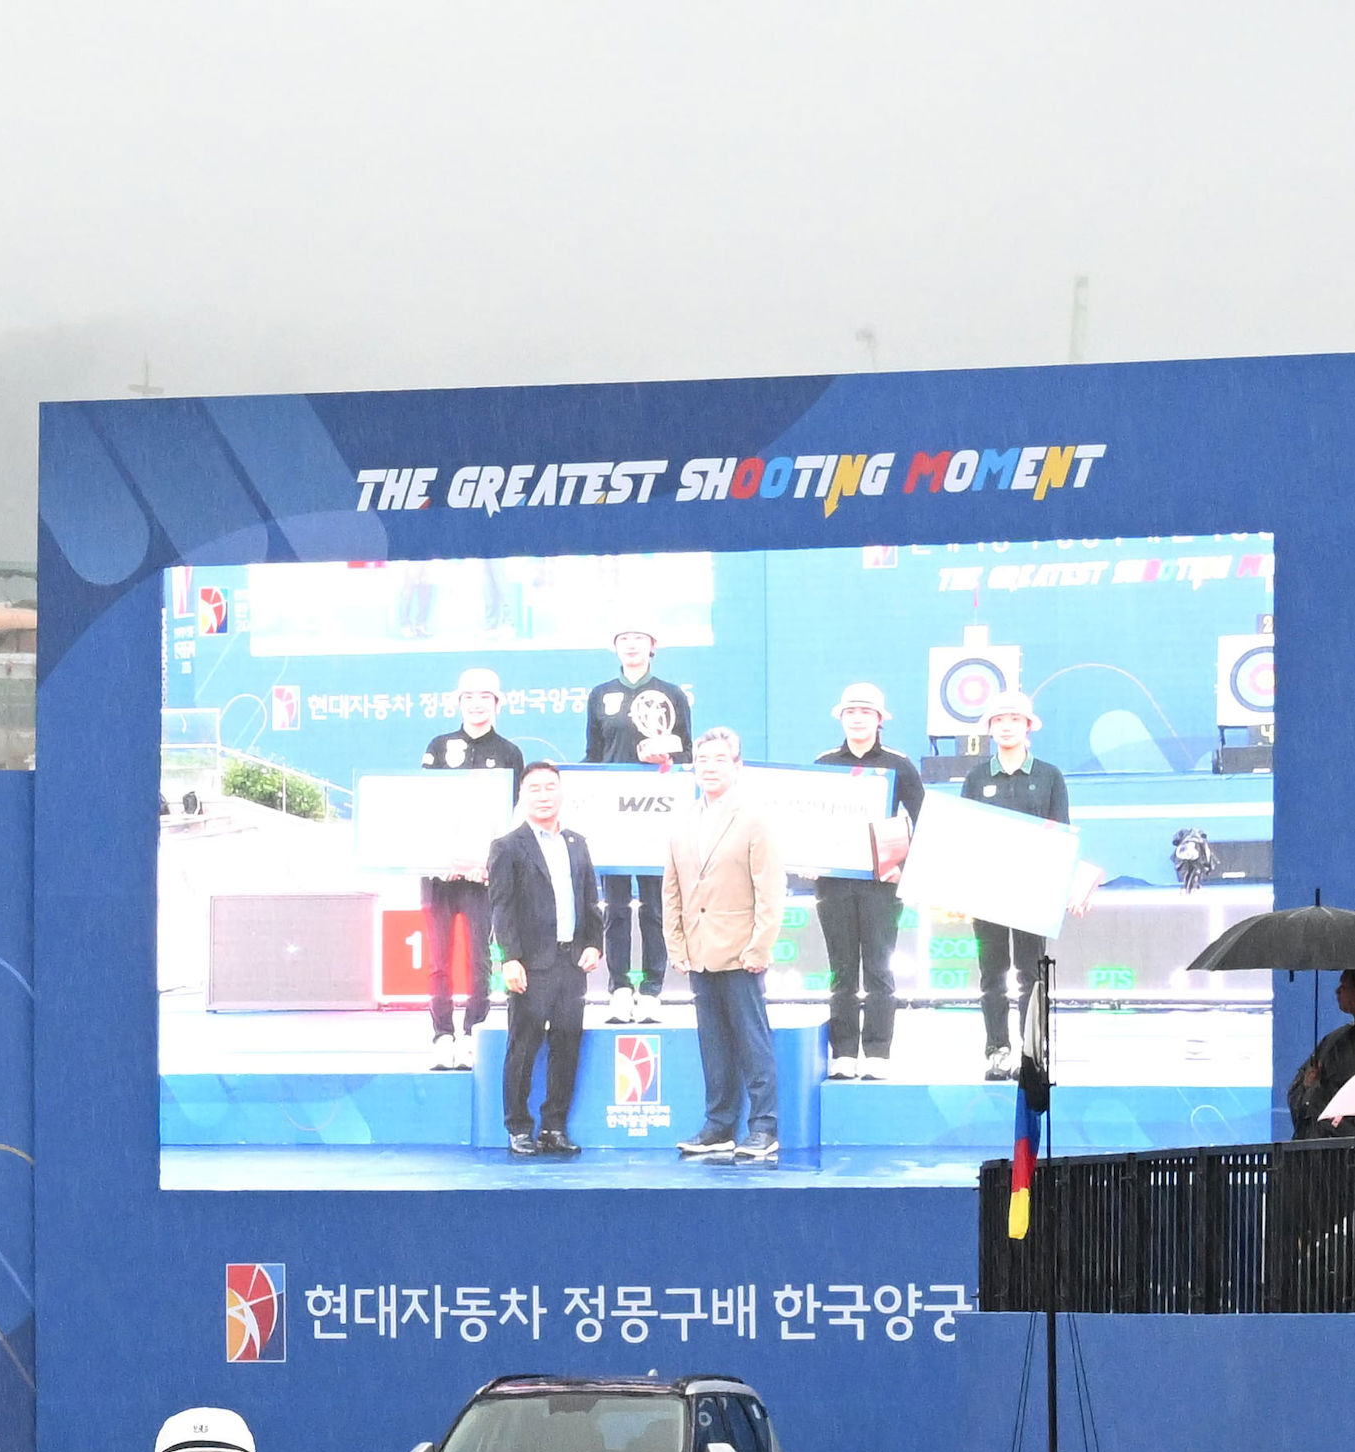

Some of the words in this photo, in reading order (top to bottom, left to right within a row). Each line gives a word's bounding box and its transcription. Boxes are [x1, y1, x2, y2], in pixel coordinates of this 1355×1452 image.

[357, 465, 433, 511] THE
[448, 460, 670, 517] GREATEST
[676, 453, 891, 518] SHOOTING
[904, 445, 1106, 500] MOMENT
[305, 1284, 547, 1342] 현대자동차
[564, 1284, 756, 1343] 정몽구배
